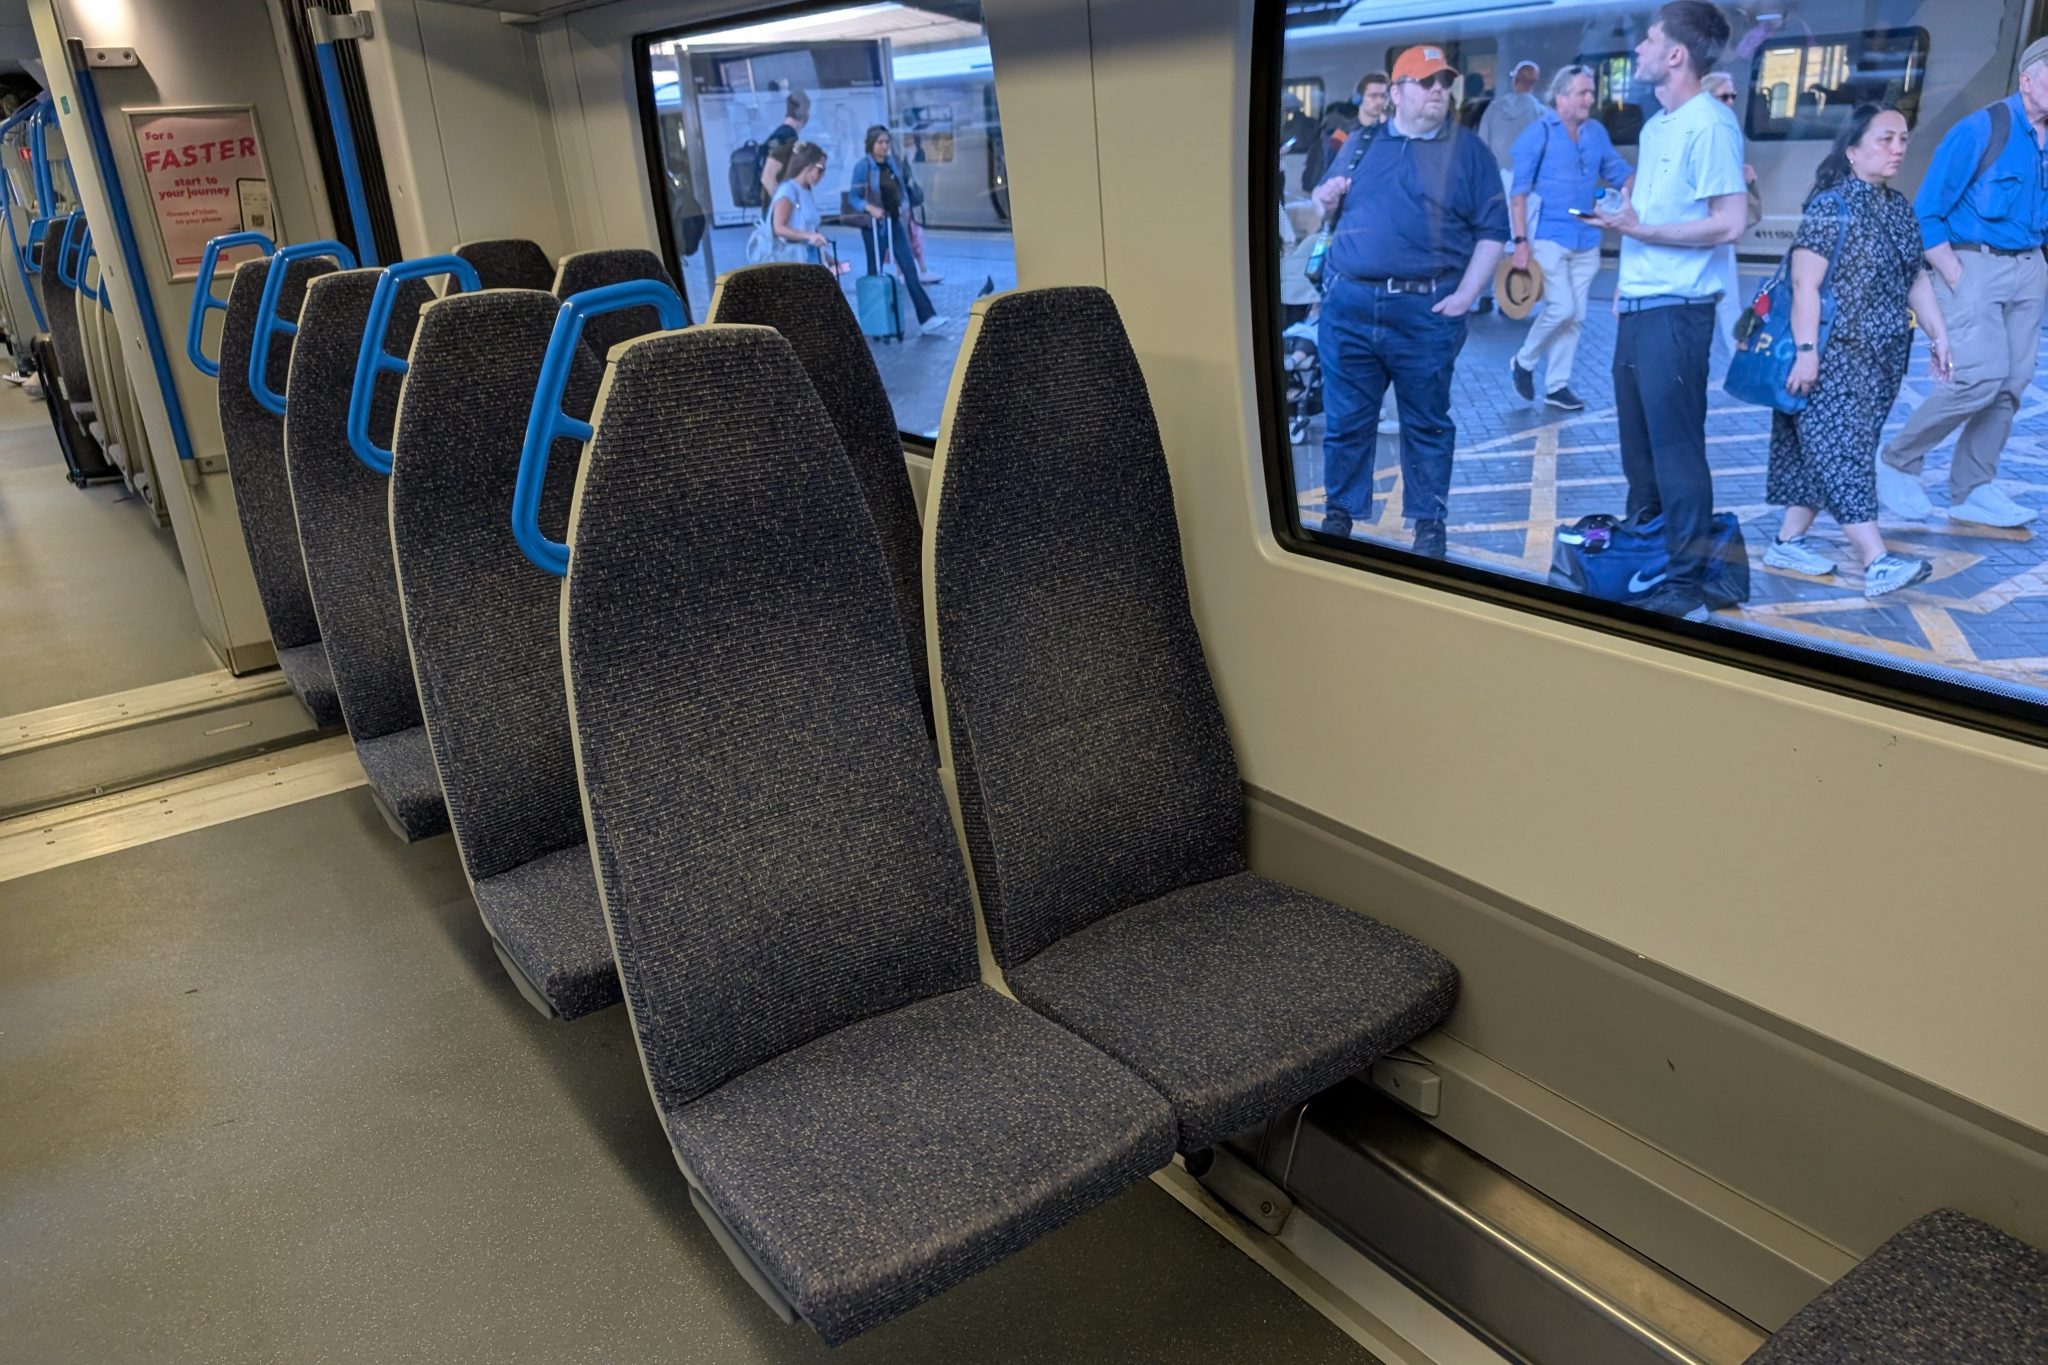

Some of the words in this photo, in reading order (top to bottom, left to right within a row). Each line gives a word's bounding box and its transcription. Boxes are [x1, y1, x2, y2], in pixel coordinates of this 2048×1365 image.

[145, 132, 164, 141] For
[167, 132, 174, 140] a
[144, 137, 256, 173] FASTER
[174, 177, 200, 187] start
[159, 189, 185, 201] your
[188, 188, 230, 199] journey
